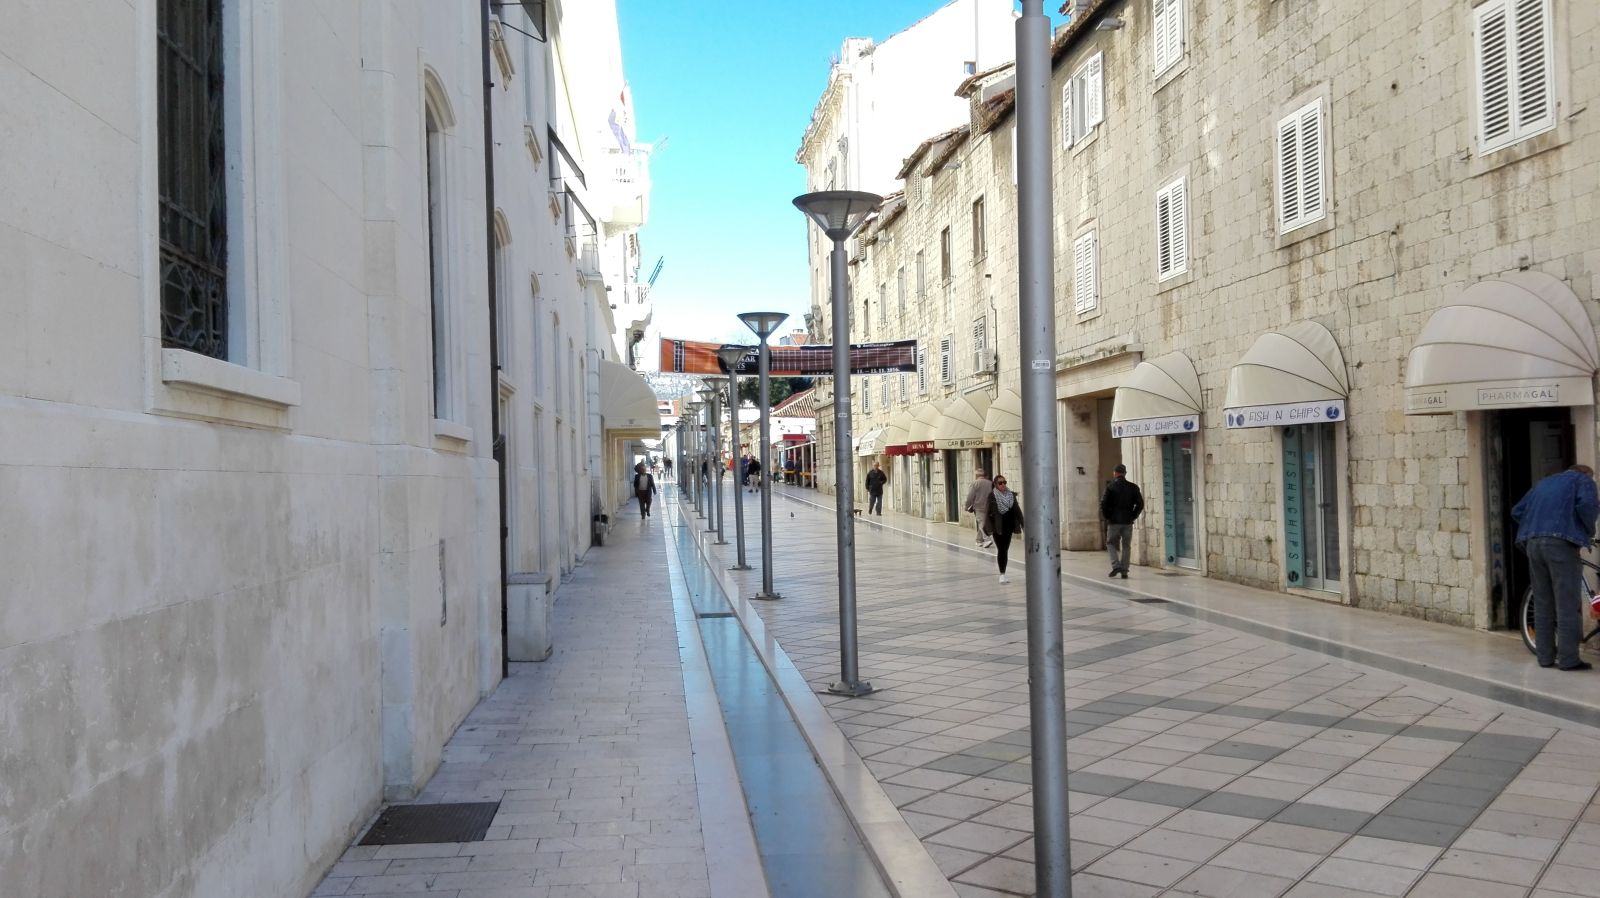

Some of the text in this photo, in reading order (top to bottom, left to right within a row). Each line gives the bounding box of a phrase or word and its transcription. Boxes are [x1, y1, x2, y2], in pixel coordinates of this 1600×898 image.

[1482, 390, 1553, 401] PHARMAGAL
[1248, 407, 1321, 422] FISH N CHIPS
[1126, 424, 1141, 433] FISH
[1155, 420, 1180, 431] CHIPS
